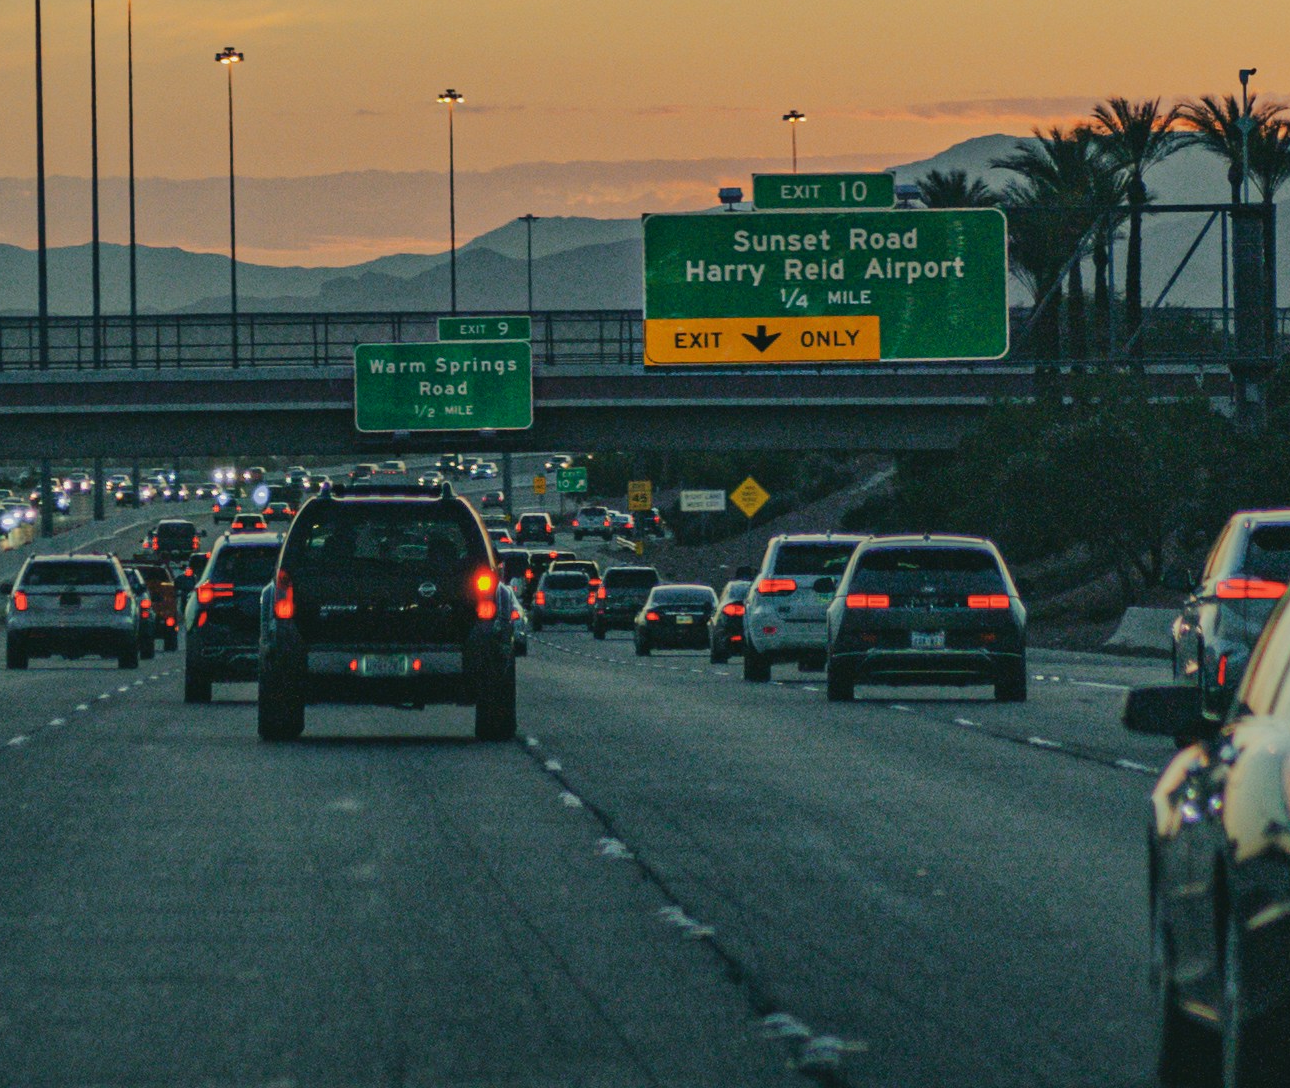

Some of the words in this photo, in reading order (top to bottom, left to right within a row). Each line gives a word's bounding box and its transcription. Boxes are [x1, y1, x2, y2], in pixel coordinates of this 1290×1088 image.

[780, 185, 821, 200] EXIT
[839, 181, 867, 201] 10
[733, 229, 830, 252] Sunset
[849, 228, 917, 250] Road
[686, 260, 765, 286] Harry
[784, 258, 844, 280] Reid
[865, 256, 965, 283] Airport
[828, 290, 871, 305] MILE
[460, 324, 486, 335] EXIT
[497, 322, 509, 335] 9
[674, 332, 722, 349] EXIT
[800, 330, 860, 348] ONLY
[369, 359, 426, 374] Warm
[435, 357, 517, 375] Springs
[419, 381, 468, 396] Road
[445, 405, 473, 415] MILE
[632, 493, 648, 503] 45
